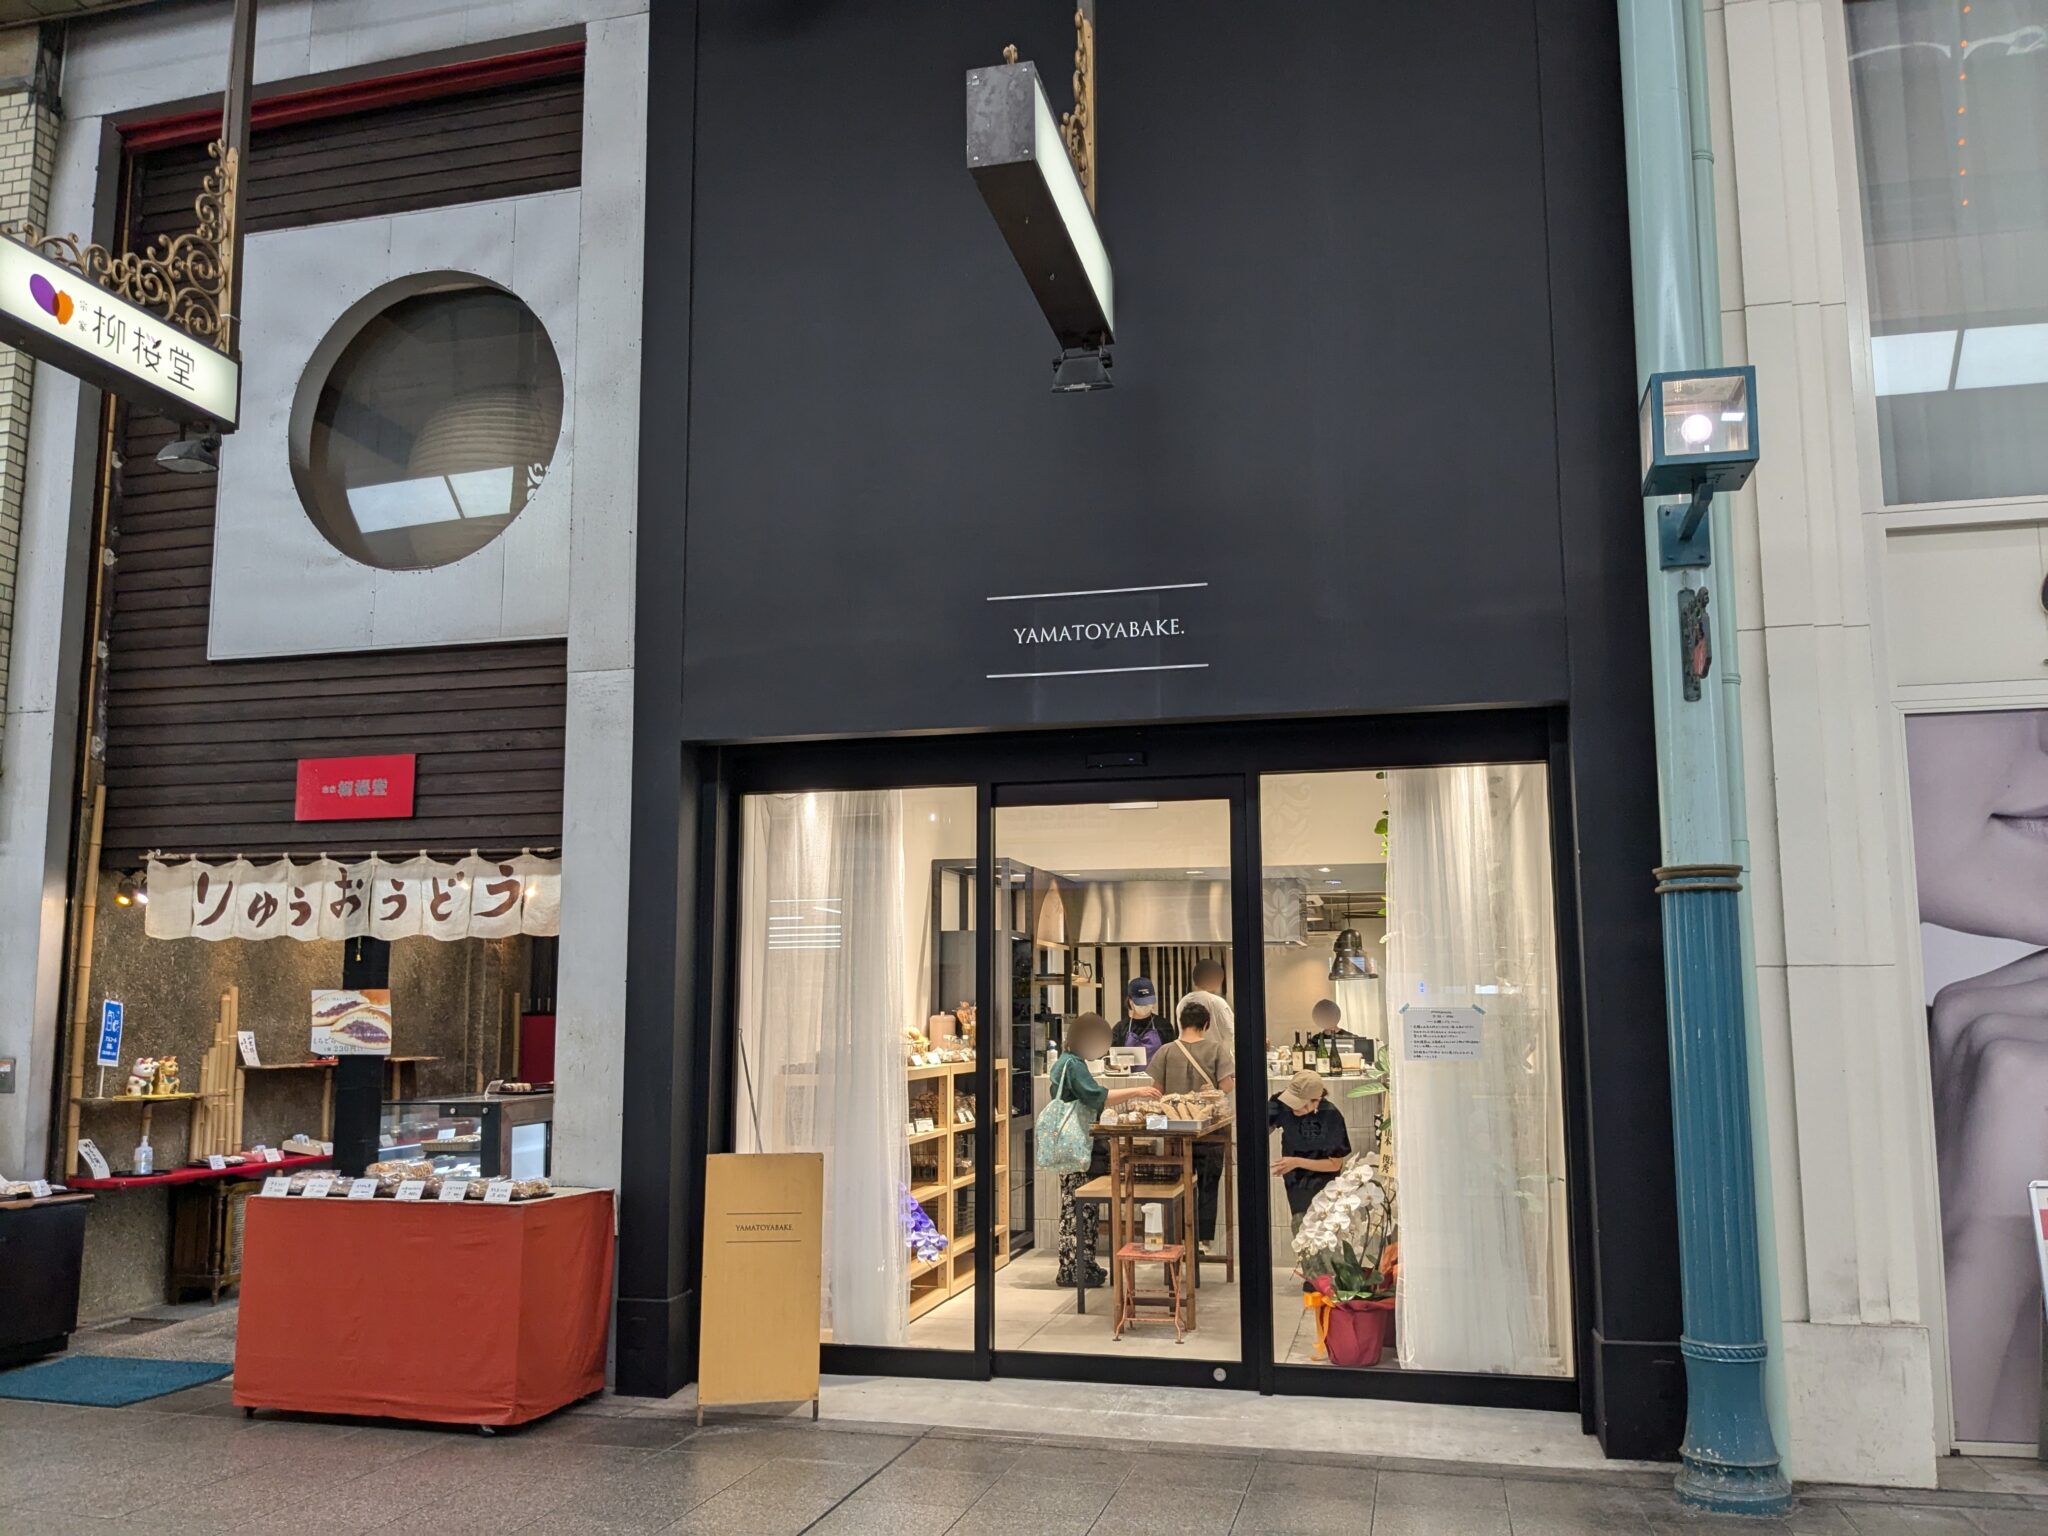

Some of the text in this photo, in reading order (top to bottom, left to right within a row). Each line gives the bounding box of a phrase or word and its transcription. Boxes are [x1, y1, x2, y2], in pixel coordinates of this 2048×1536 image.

[93, 306, 195, 391] 柳桜堂
[1013, 618, 1185, 644] YAMATOYABAKE.
[197, 865, 521, 928] りゅうおうどう
